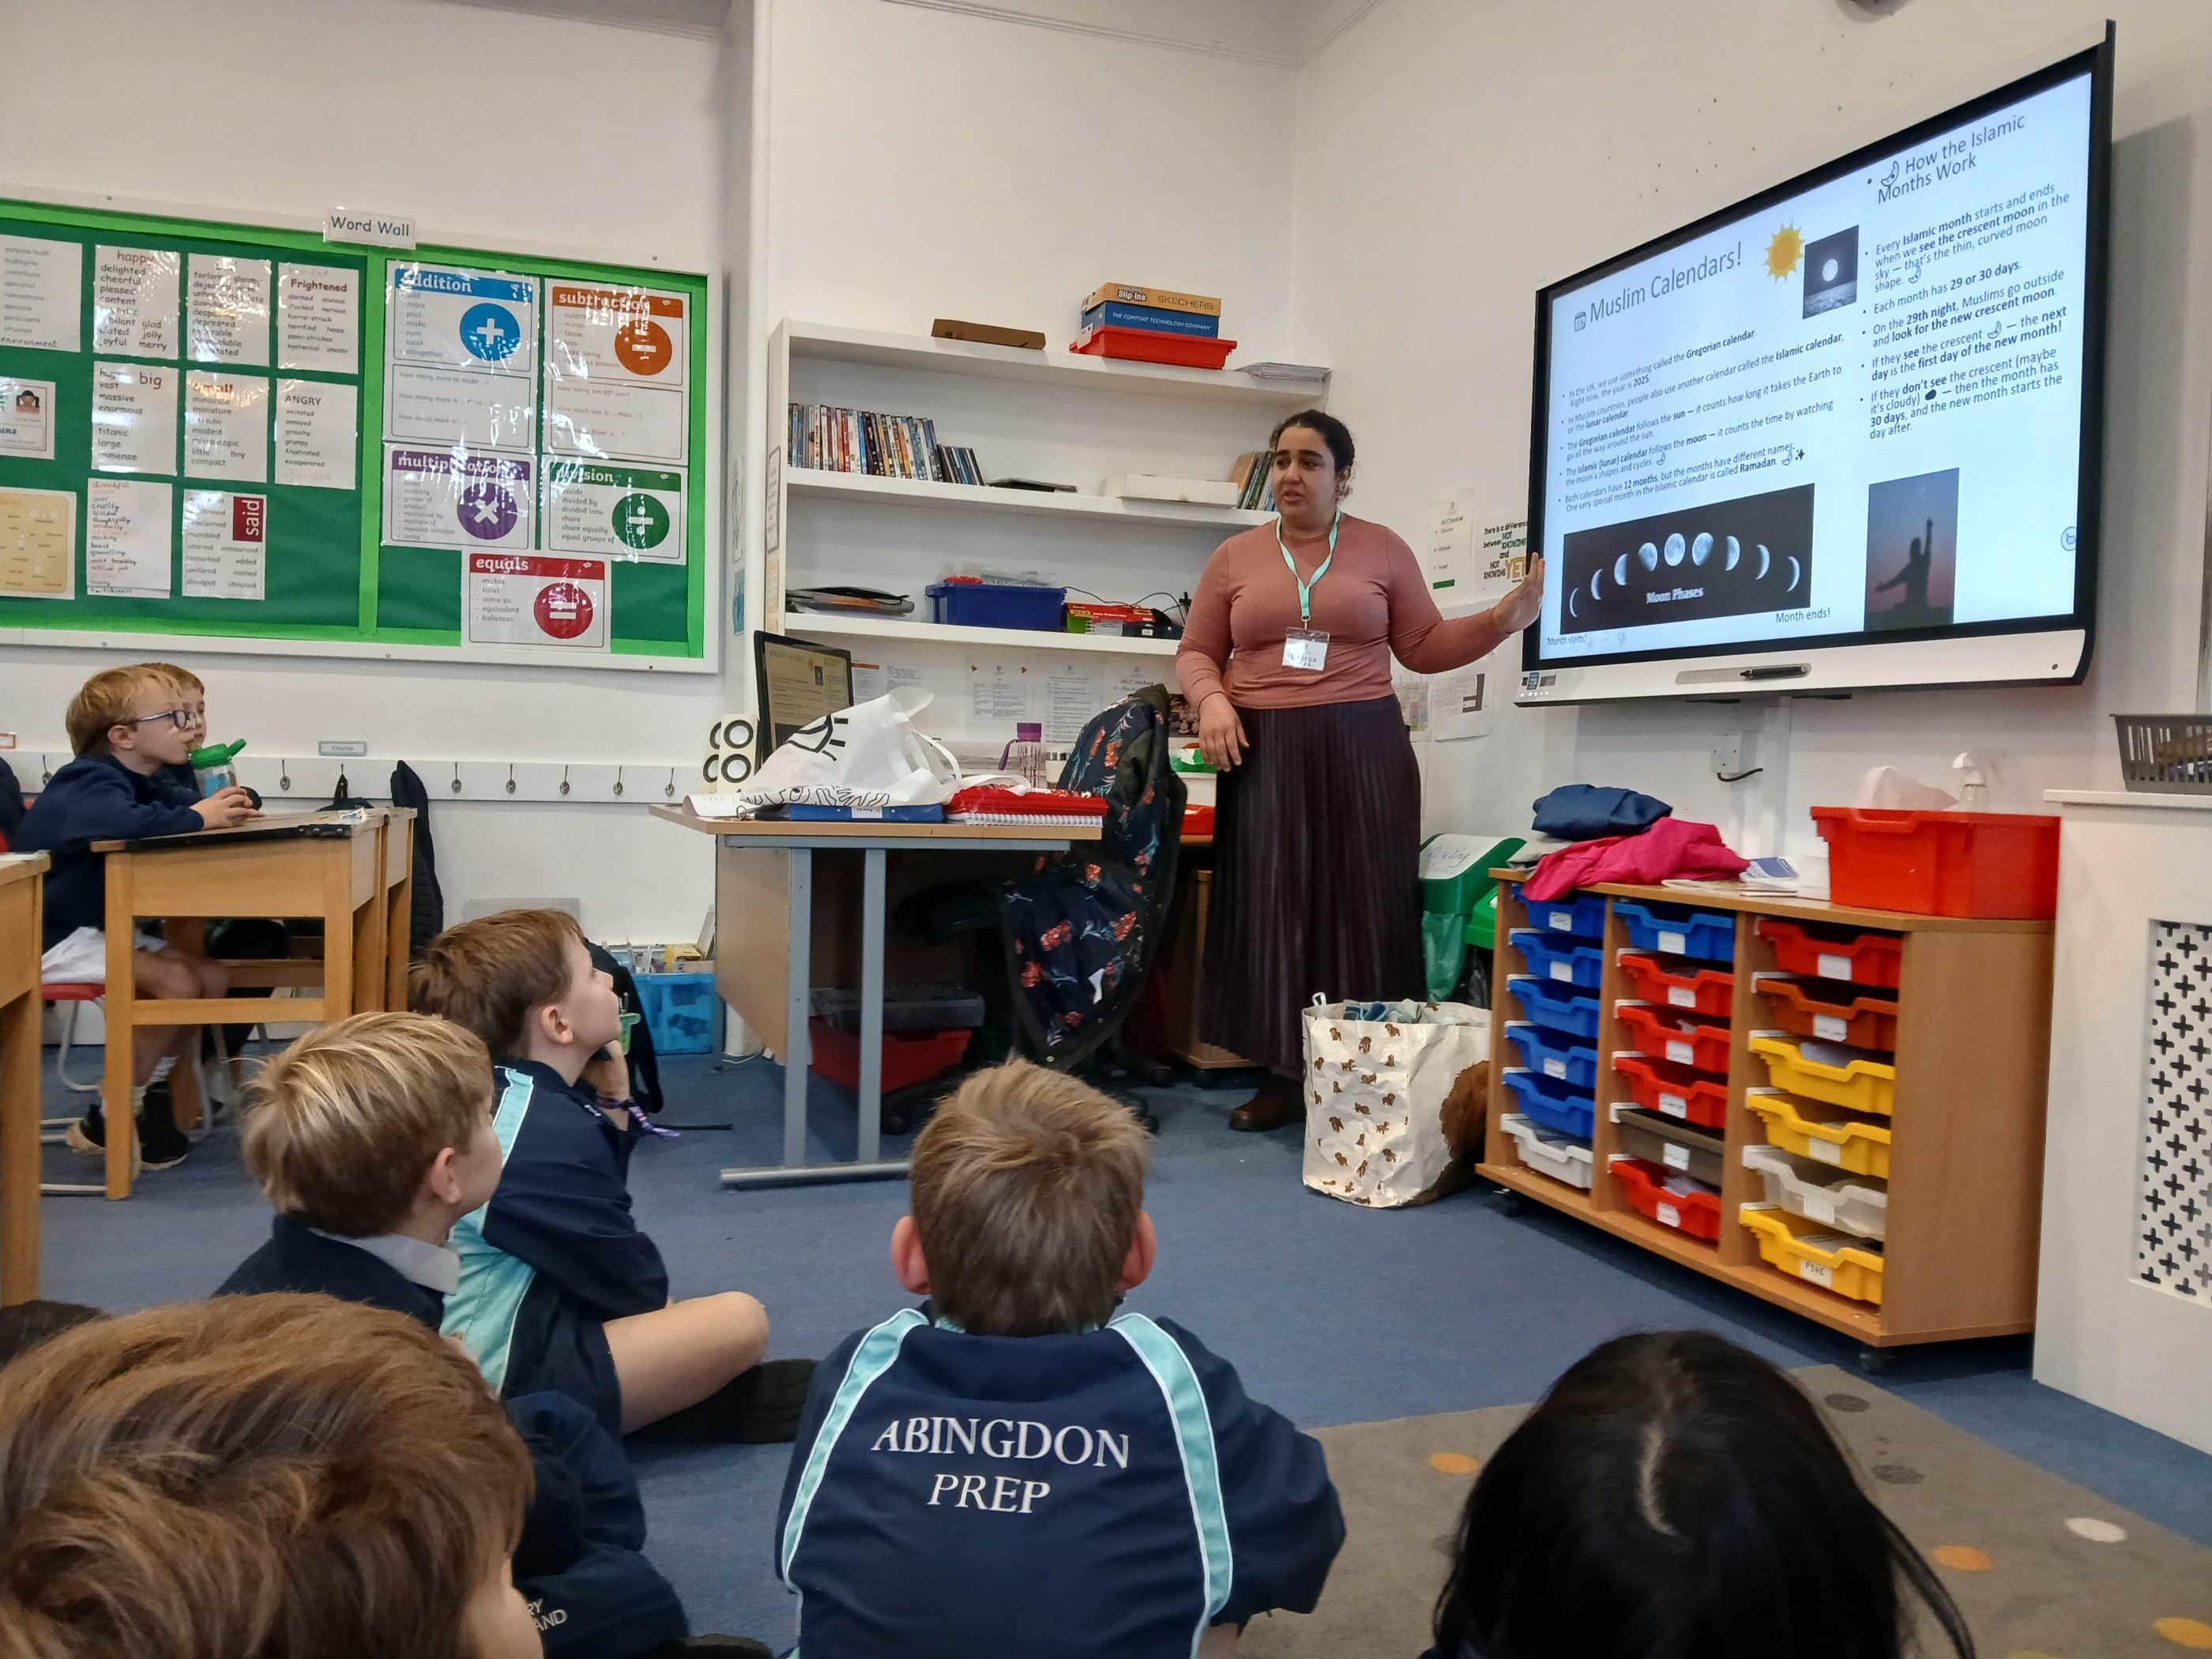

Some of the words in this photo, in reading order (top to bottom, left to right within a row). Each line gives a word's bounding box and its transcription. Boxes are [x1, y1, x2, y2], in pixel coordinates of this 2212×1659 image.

[1905, 151, 1937, 175] How
[1941, 140, 1966, 160] the
[1971, 115, 2025, 148] Islamic
[1878, 172, 1931, 204] Months
[1936, 152, 1976, 181] Work
[330, 216, 372, 232] Word
[378, 221, 409, 236] Wall
[1875, 239, 1900, 255] Every
[1902, 226, 1936, 246] Islamic
[1938, 212, 1972, 233] month
[1974, 202, 2003, 220] starts
[2006, 191, 2026, 209] and
[2029, 182, 2055, 201] ends
[1875, 250, 1900, 268] when
[1902, 246, 1917, 258] we
[1918, 239, 1936, 253] see
[1938, 233, 1954, 246] the
[1956, 216, 2000, 239] crescent
[2003, 205, 2034, 224] moon
[2037, 200, 2048, 212] in
[2051, 193, 2069, 207] the
[1875, 265, 1890, 280] sky
[1904, 252, 1931, 270] that's
[1933, 248, 1950, 261] the
[1952, 239, 1974, 254] thin,
[1977, 223, 2013, 246] curved
[2015, 215, 2047, 233] moon
[117, 250, 155, 266] happy
[101, 264, 145, 276] delighted
[100, 274, 141, 285] cheerful
[290, 278, 348, 292] Frightened
[1589, 287, 1645, 322] Muslim
[1650, 240, 1741, 298] Calendars!
[1873, 299, 1894, 314] Each
[1897, 288, 1928, 307] month
[1931, 284, 1947, 296] has
[1950, 276, 1962, 291] 29
[1965, 274, 1977, 284] or
[1978, 267, 1992, 281] 30
[1994, 261, 2021, 276] days.
[1874, 276, 1903, 292] shape.
[100, 285, 136, 295] pleased
[100, 296, 136, 306] content
[1157, 295, 1214, 310] SKECHERS
[1872, 323, 1886, 334] On
[1888, 318, 1904, 330] the
[1905, 309, 1928, 325] 29th
[1930, 301, 1958, 318] night,
[1962, 288, 2004, 309] Muslims
[2007, 284, 2020, 297] go
[2023, 269, 2064, 290] outside
[141, 320, 162, 329] glad
[1872, 332, 1890, 348] and
[1891, 326, 1912, 341] look
[1914, 323, 1929, 335] for
[1931, 315, 1947, 330] the
[1950, 310, 1972, 325] new
[1974, 295, 2018, 318] crescent
[2022, 288, 2054, 305] moon.
[2020, 314, 2038, 328] the
[2041, 306, 2067, 322] next
[141, 328, 162, 340] jolly
[138, 340, 167, 352] merry
[1686, 340, 1721, 359] Gregorian
[1722, 329, 1756, 347] calendar.
[1775, 344, 1804, 360] Islamic
[1804, 333, 1843, 351] calendar,
[1871, 369, 1888, 381] day
[1890, 363, 1898, 376] is
[1899, 361, 1915, 373] the
[1917, 354, 1937, 369] first
[1939, 350, 1958, 363] day
[1960, 344, 1972, 357] of
[1973, 337, 1993, 354] the
[1994, 335, 2018, 348] new
[2019, 319, 2061, 341] month!
[1872, 356, 1879, 369] If
[1880, 353, 1902, 366] they
[1902, 348, 1920, 359] see
[1921, 342, 1937, 355] the
[1939, 329, 1982, 350] crescent
[139, 371, 163, 390] big
[1632, 374, 1649, 387] 2025
[1871, 390, 1878, 402] If
[1879, 387, 1900, 400] they
[1902, 378, 1928, 394] don't
[1929, 376, 1947, 388] see
[1949, 370, 1966, 383] the
[1968, 357, 2012, 378] crescent
[2015, 348, 2056, 368] (maybe
[1954, 381, 1978, 394] then
[1981, 374, 1998, 388] the
[2000, 363, 2037, 383] month
[2037, 361, 2059, 374] has
[99, 382, 119, 390] vast
[99, 393, 136, 403] massive
[284, 395, 322, 405] ANGRY
[1870, 416, 1882, 427] 30
[1883, 412, 1907, 423] days,
[1909, 403, 1928, 417] and
[1930, 401, 1947, 413] the
[1949, 396, 1970, 408] new
[1973, 385, 2007, 404] month
[2010, 378, 2041, 395] starts
[2043, 374, 2062, 386] the
[1870, 402, 1884, 415] it's
[1885, 392, 1920, 411] cloudy)
[98, 404, 144, 416] enormous
[192, 406, 233, 415] miniature
[98, 427, 129, 437] titanic
[1869, 427, 1886, 439] day
[1887, 422, 1912, 435] after.
[97, 438, 122, 450] large
[190, 458, 228, 467] compact
[1739, 457, 1778, 472] Ramadan.
[242, 500, 261, 536] said
[476, 556, 529, 574] equals
[1775, 611, 1804, 623] Month
[1806, 606, 1830, 619] ends!
[871, 1416, 1130, 1469] ABINGDON
[927, 1473, 1051, 1513] PREP
